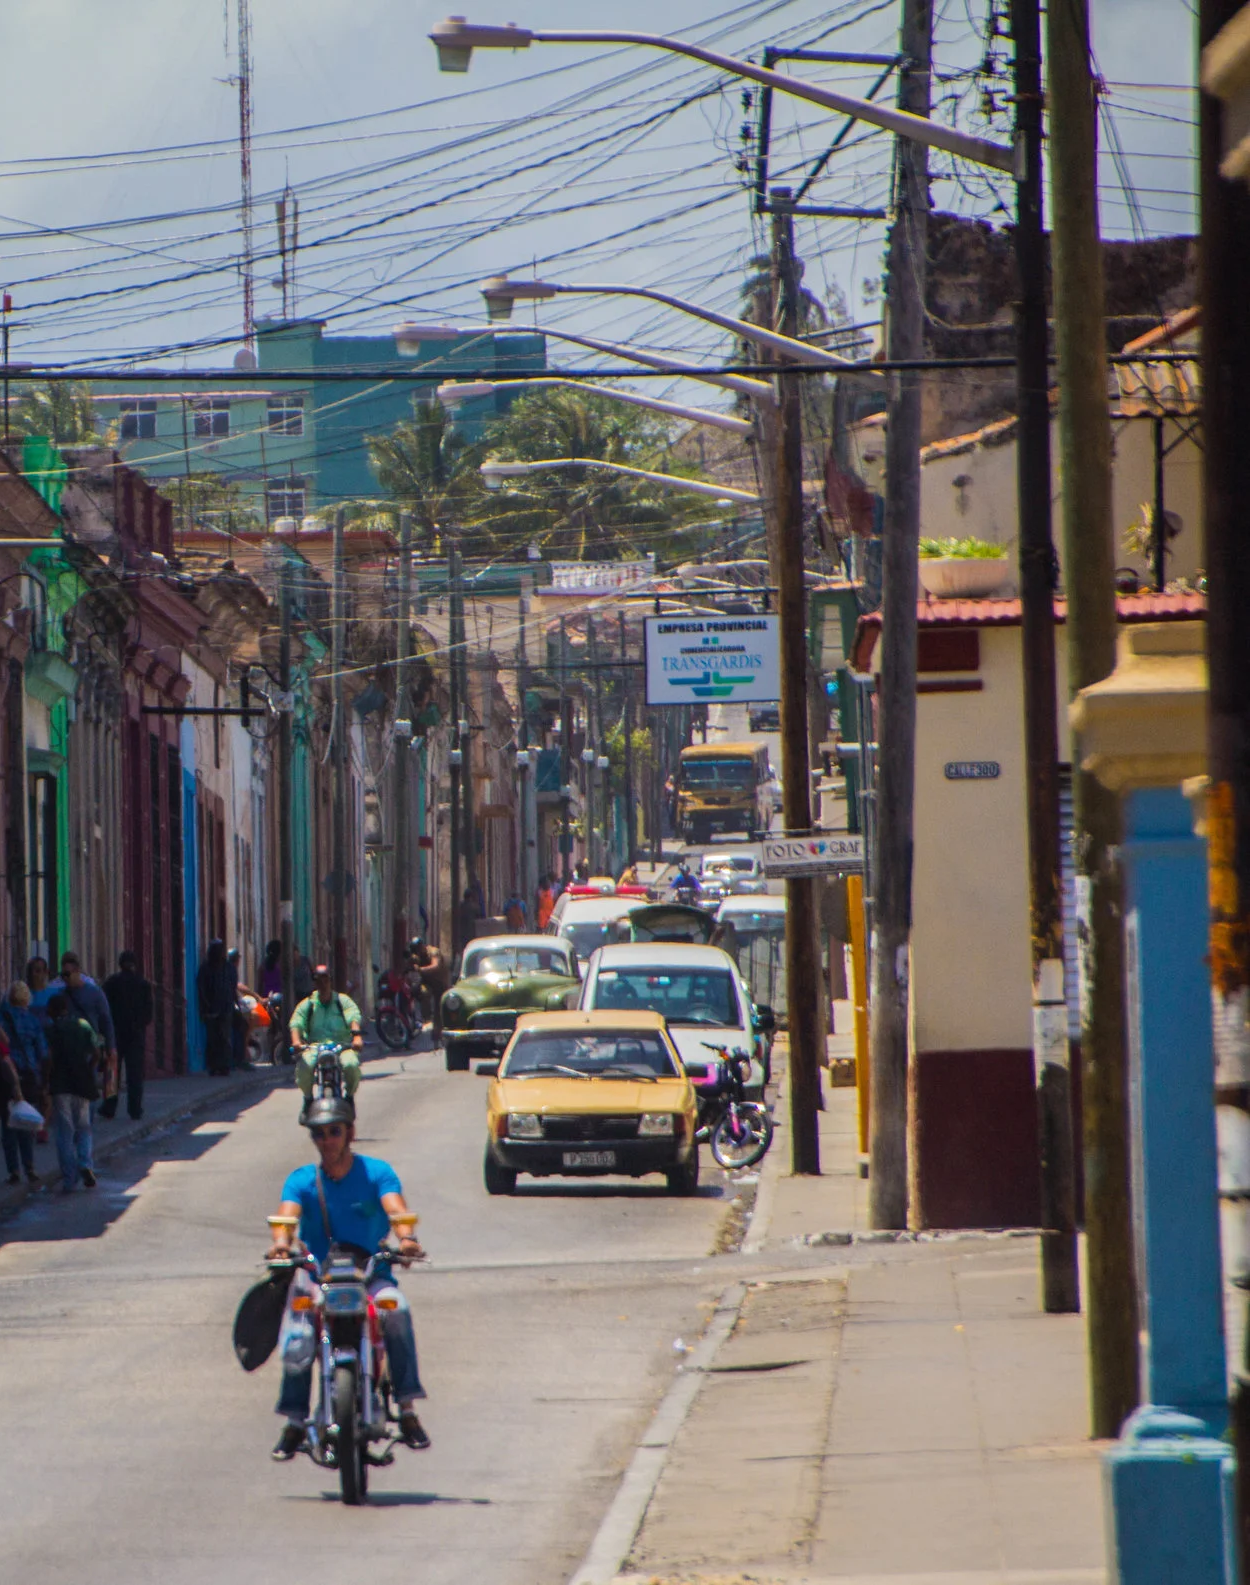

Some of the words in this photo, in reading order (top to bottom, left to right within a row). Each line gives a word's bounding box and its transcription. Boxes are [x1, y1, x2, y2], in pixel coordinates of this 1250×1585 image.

[657, 622, 704, 634] EMPRESA
[706, 620, 768, 632] PROVINCIAL
[662, 655, 762, 671] TRANSGARDIS
